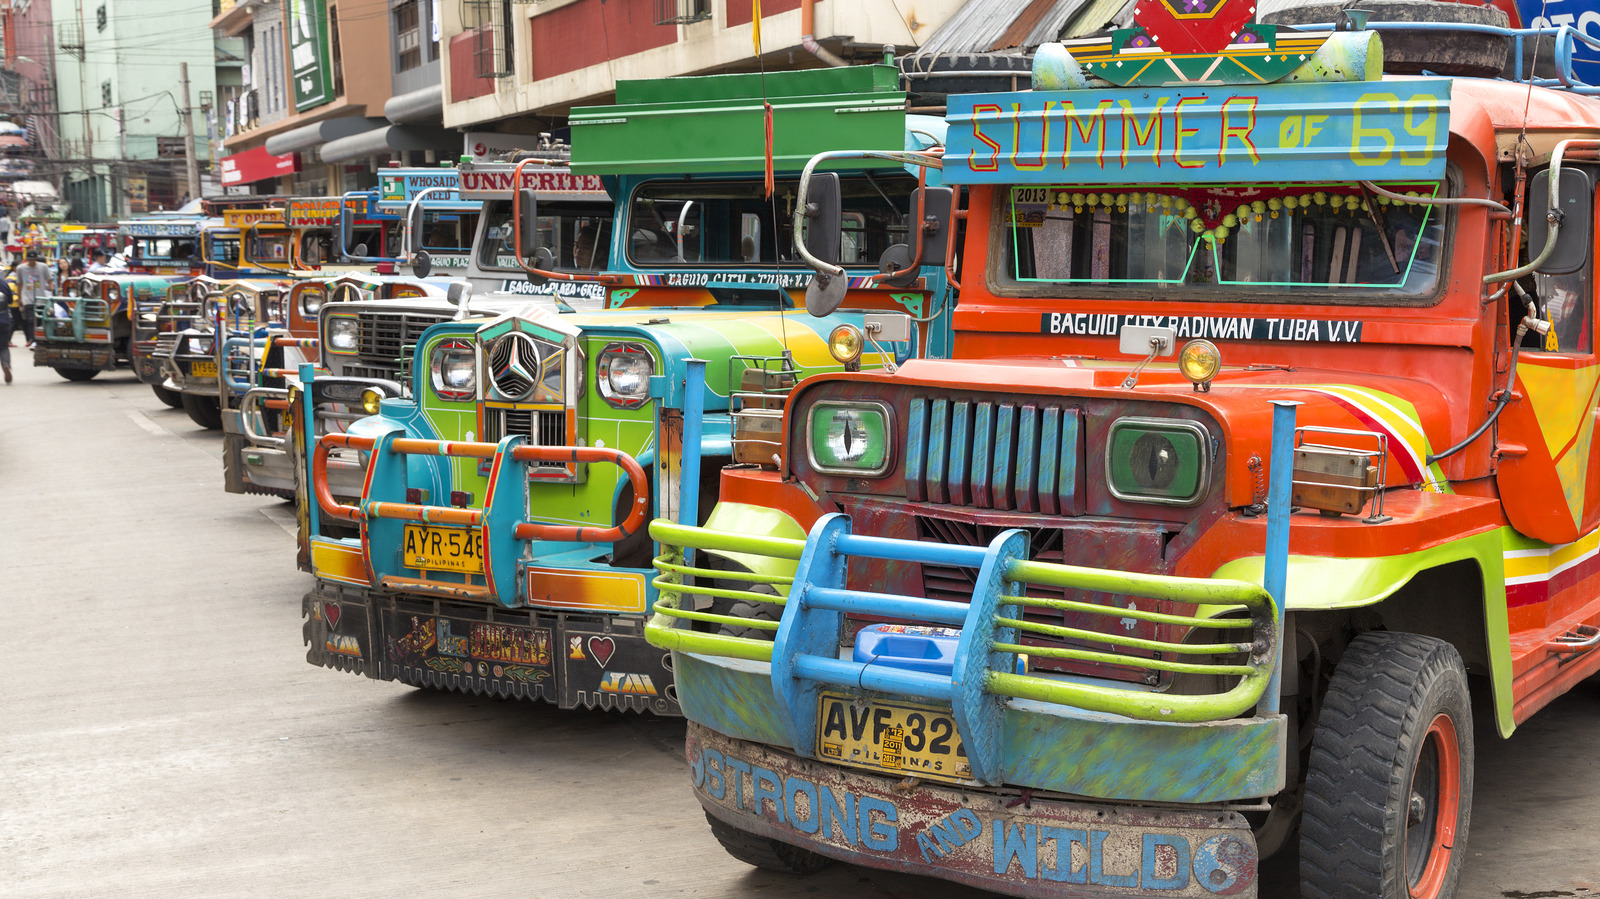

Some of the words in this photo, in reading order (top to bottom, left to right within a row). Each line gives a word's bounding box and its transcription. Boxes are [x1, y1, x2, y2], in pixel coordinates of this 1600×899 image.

[967, 96, 1261, 172] SUMMER
[1279, 115, 1330, 148] OF
[1349, 93, 1439, 166] 69
[426, 190, 451, 200] NEED
[1017, 189, 1046, 202] 2013
[130, 224, 157, 235] FRAU
[430, 257, 451, 267] AGUIO
[453, 257, 469, 267] PLAZ
[668, 273, 709, 287] BAGUIO
[1050, 313, 1118, 336] BAGUIO
[1266, 318, 1320, 342] TUBA
[427, 558, 465, 568] PILIPINAS
[824, 702, 892, 745] AVF
[884, 740, 901, 750] 2011
[853, 748, 943, 771] PILINAS
[704, 747, 898, 853] STRONG
[915, 808, 983, 864] AND
[993, 819, 1190, 890] WILD
